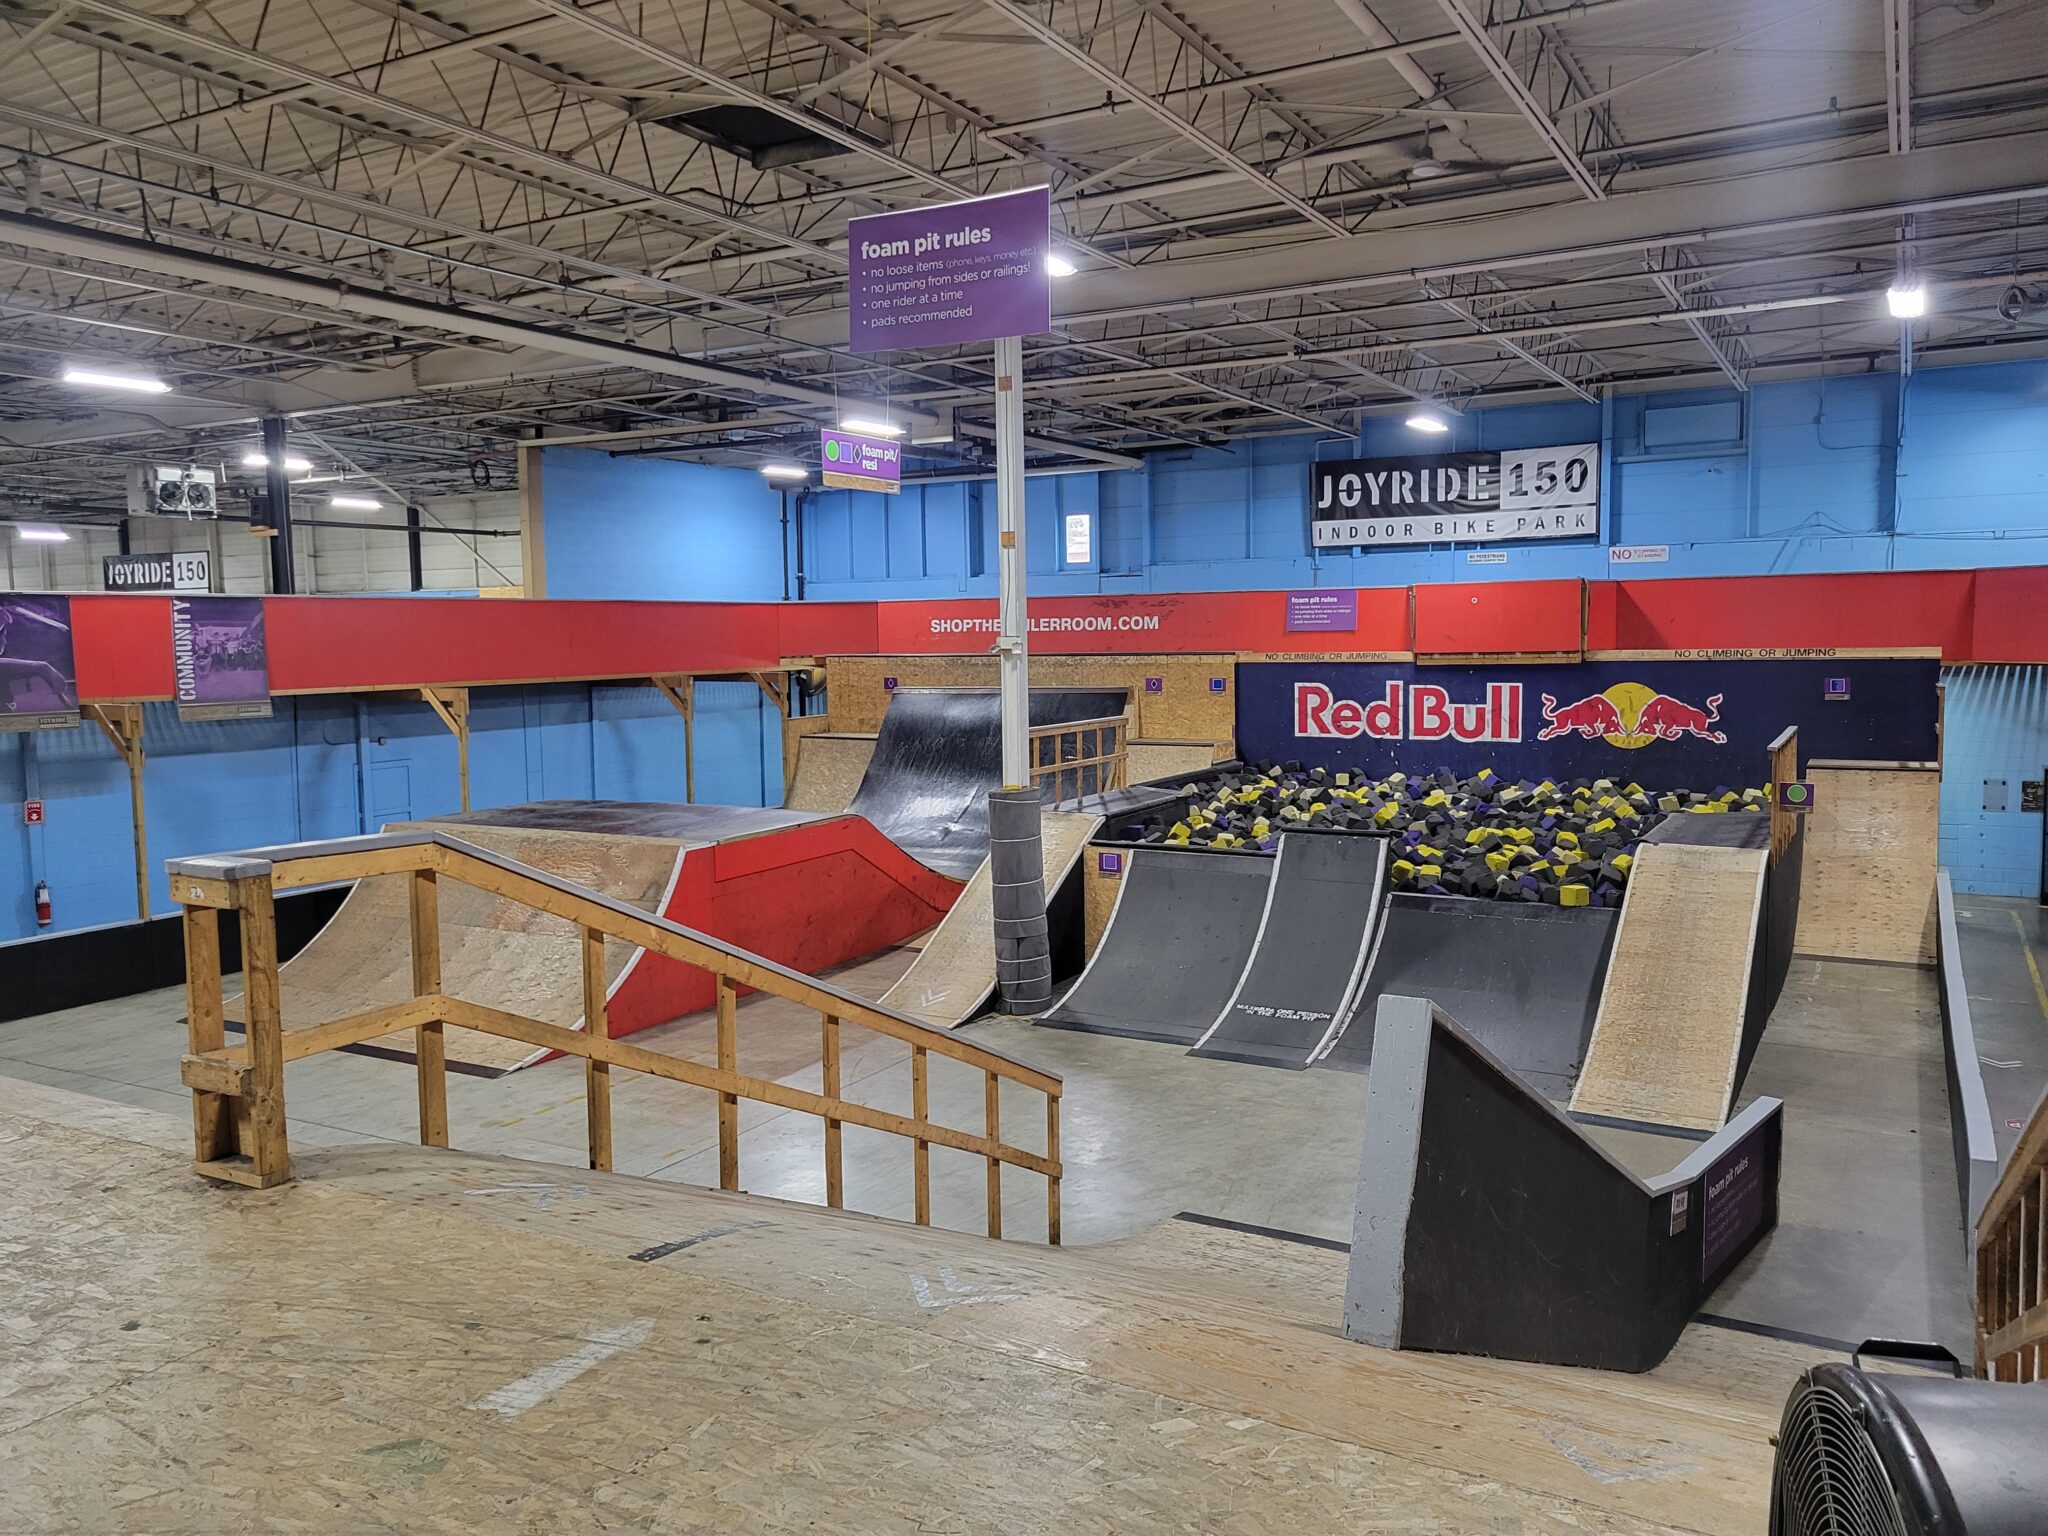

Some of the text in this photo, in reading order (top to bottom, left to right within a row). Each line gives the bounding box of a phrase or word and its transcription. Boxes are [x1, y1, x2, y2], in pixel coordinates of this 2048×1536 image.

[861, 227, 991, 259] foam pit rules
[871, 269, 884, 278] no
[886, 263, 913, 276] loose
[916, 260, 943, 272] items
[993, 250, 1018, 262] money
[871, 262, 1031, 294] no jumping from sides or railings!
[871, 289, 963, 310] one rider at a time
[871, 306, 972, 329] pads recommended
[862, 444, 899, 463] foam pit/
[862, 459, 878, 471] resi
[1318, 458, 1588, 508] JOYRIDE 150
[1319, 514, 1585, 540] INDOOR BIKE PARK
[1612, 549, 1631, 560] NO
[108, 560, 205, 585] JOYRIDE 150
[1310, 596, 1320, 604] pit
[931, 616, 1159, 633] SHOPTHEILERROOM.COM
[173, 599, 197, 701] COMMUNITY
[1265, 652, 1387, 661] NO CLIMBING OR JUMPING
[1674, 648, 1837, 658] NO CLIMBING OR JUMPING
[1295, 680, 1522, 742] Red Bull
[1708, 1177, 1725, 1201] foam
[1725, 1168, 1734, 1189] pit
[1734, 1156, 1749, 1177] rules
